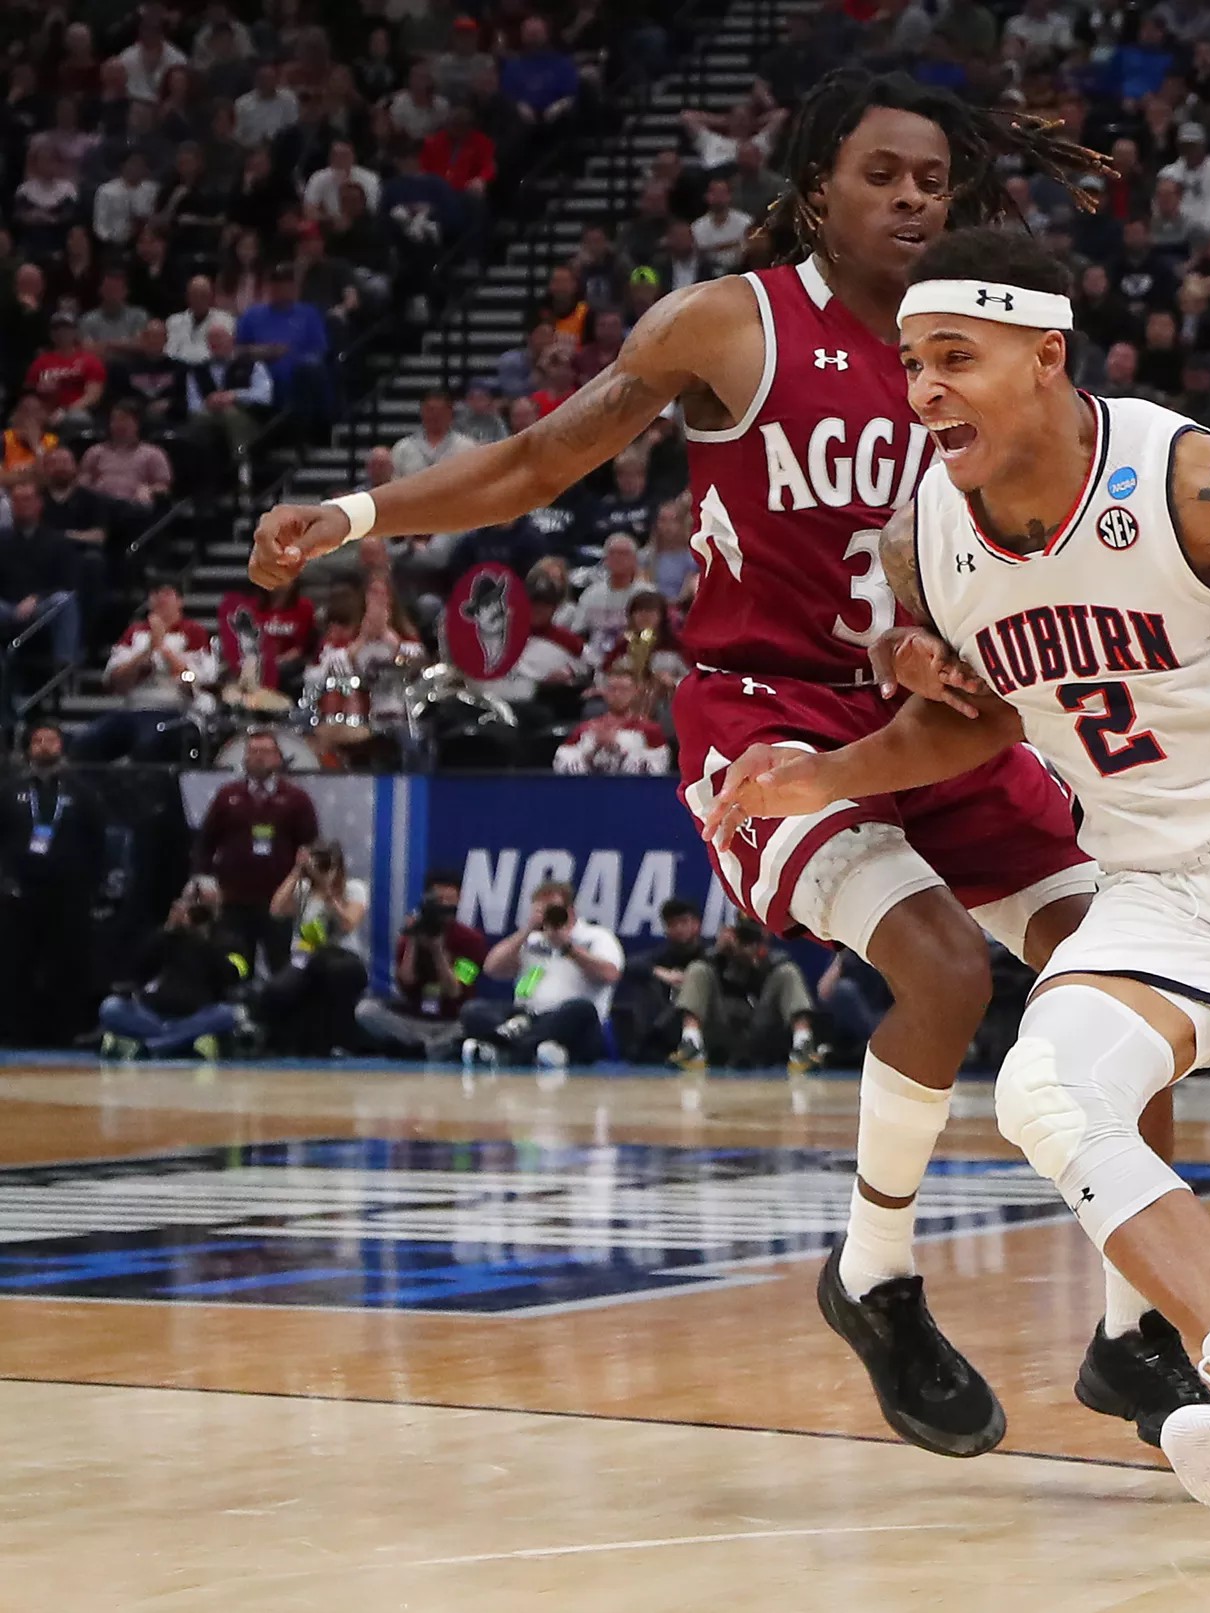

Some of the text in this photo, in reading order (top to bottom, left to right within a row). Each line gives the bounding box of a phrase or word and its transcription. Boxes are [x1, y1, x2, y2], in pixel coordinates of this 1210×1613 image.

[759, 417, 942, 511] AGGI
[1100, 509, 1137, 547] SEC
[832, 528, 896, 647] 3
[975, 605, 1182, 697] AUBURN
[1055, 680, 1168, 778] 2
[455, 849, 677, 936] NCAA
